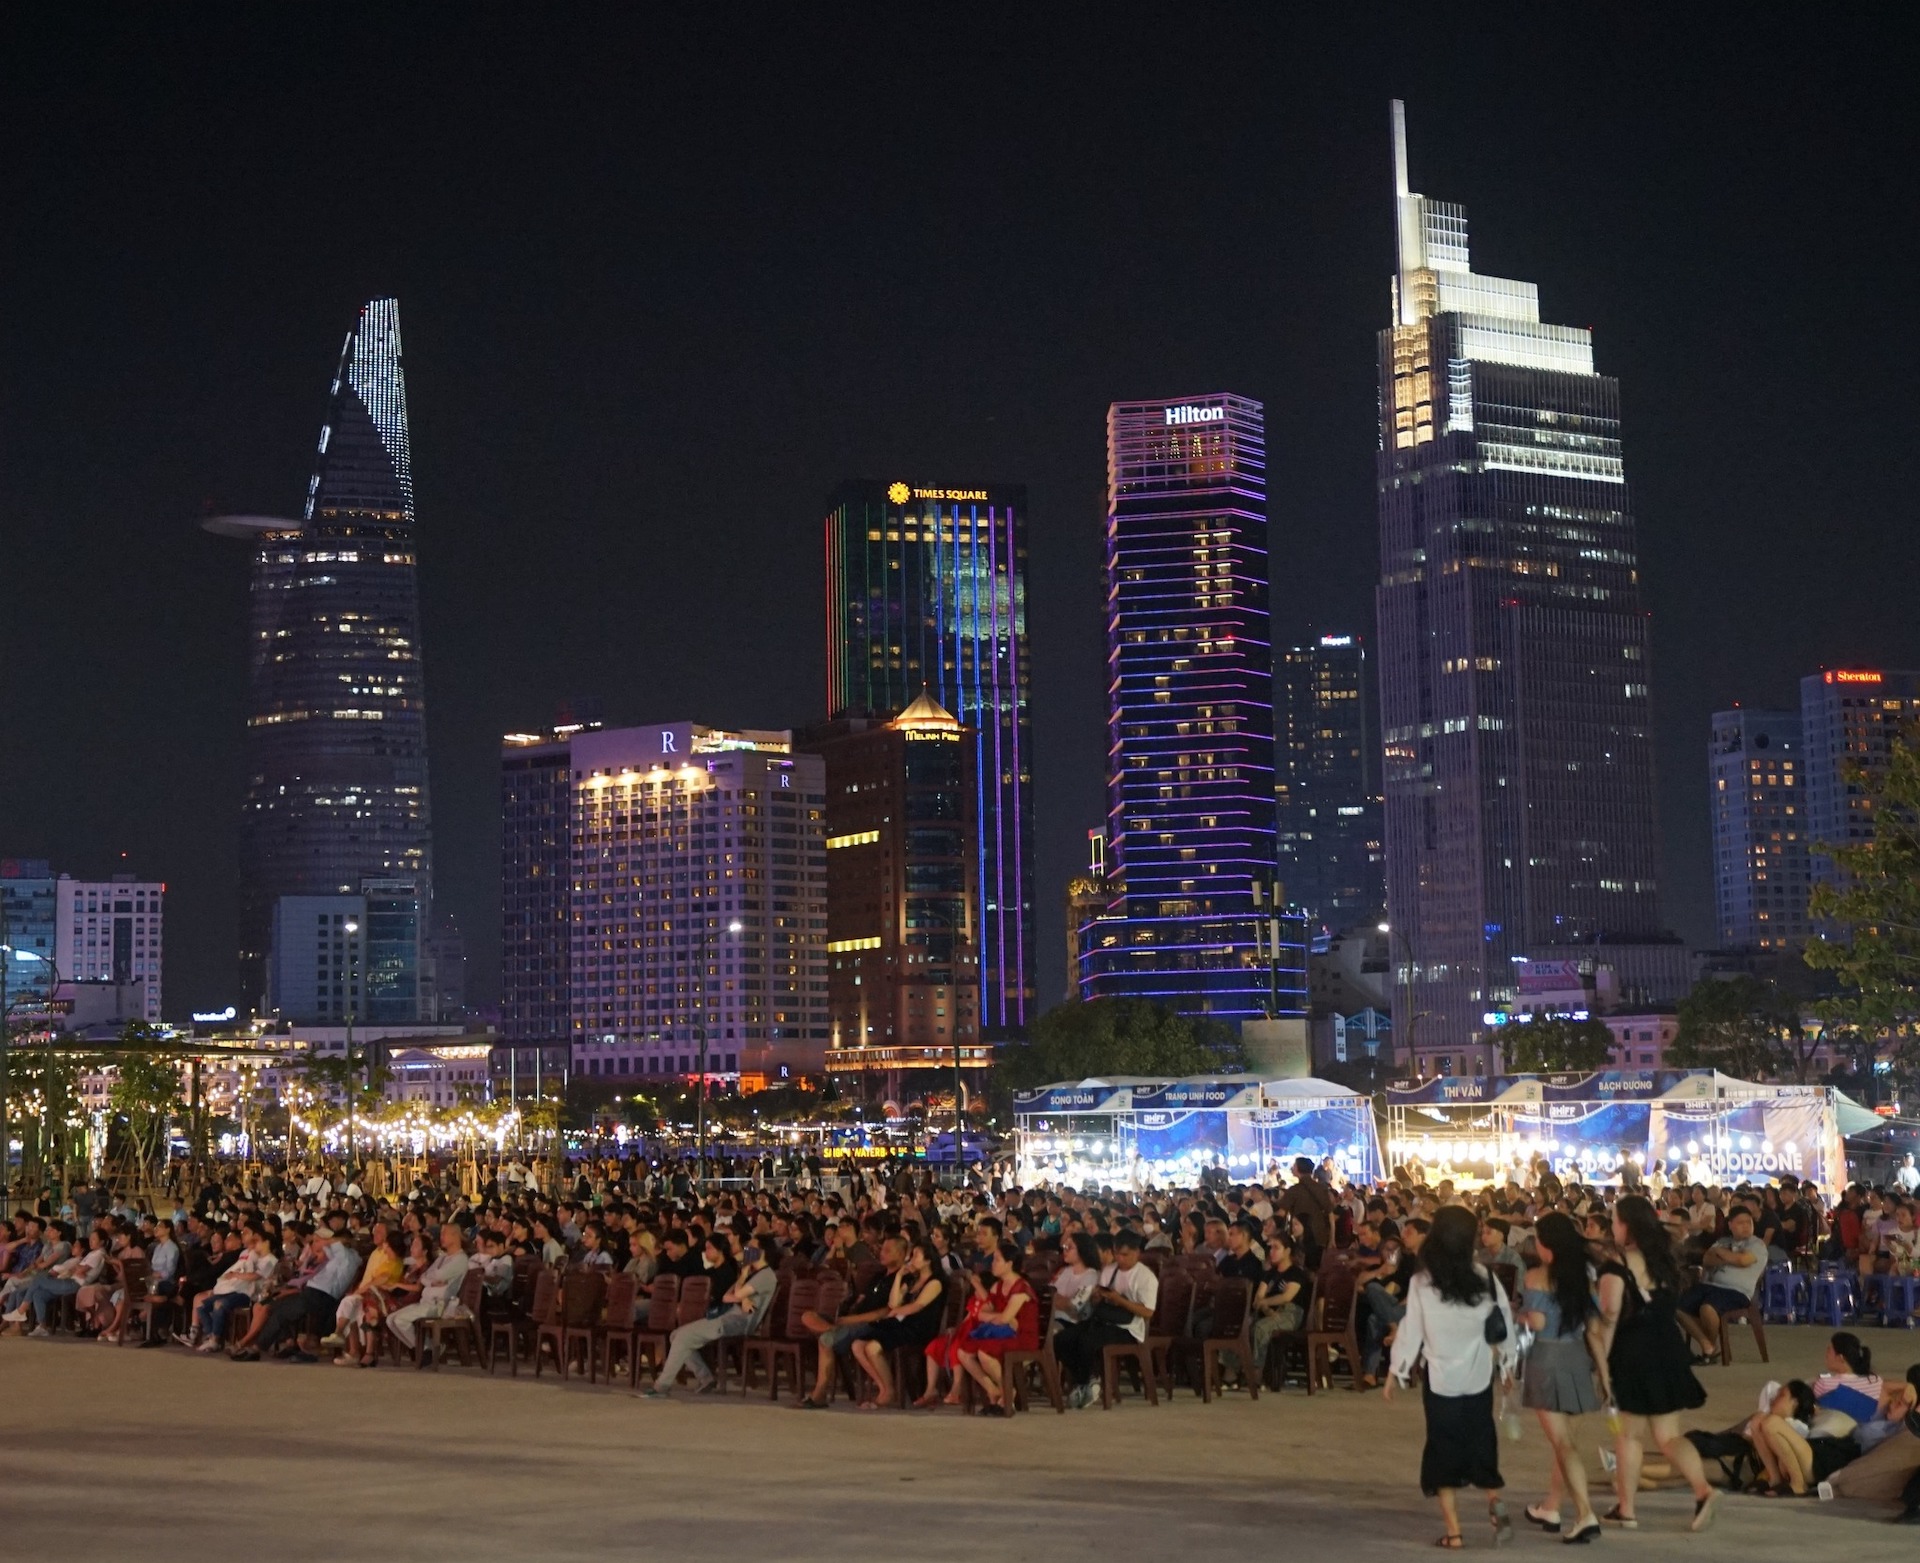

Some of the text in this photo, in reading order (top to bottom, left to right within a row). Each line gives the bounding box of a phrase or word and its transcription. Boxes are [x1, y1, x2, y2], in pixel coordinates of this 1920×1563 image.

[1165, 405, 1224, 425] Hilton
[913, 488, 988, 500] TIMES SQUARE
[1837, 671, 1881, 682] Sheraton
[661, 731, 679, 753] R
[781, 774, 790, 787] R
[781, 1066, 789, 1078] R
[1164, 1091, 1226, 1101] TRANG LINH FOOD
[1443, 1086, 1459, 1098] THI
[1050, 1095, 1072, 1105] SONG
[852, 1147, 896, 1158] WATERBS
[1701, 1152, 1803, 1172] FOODZONE
